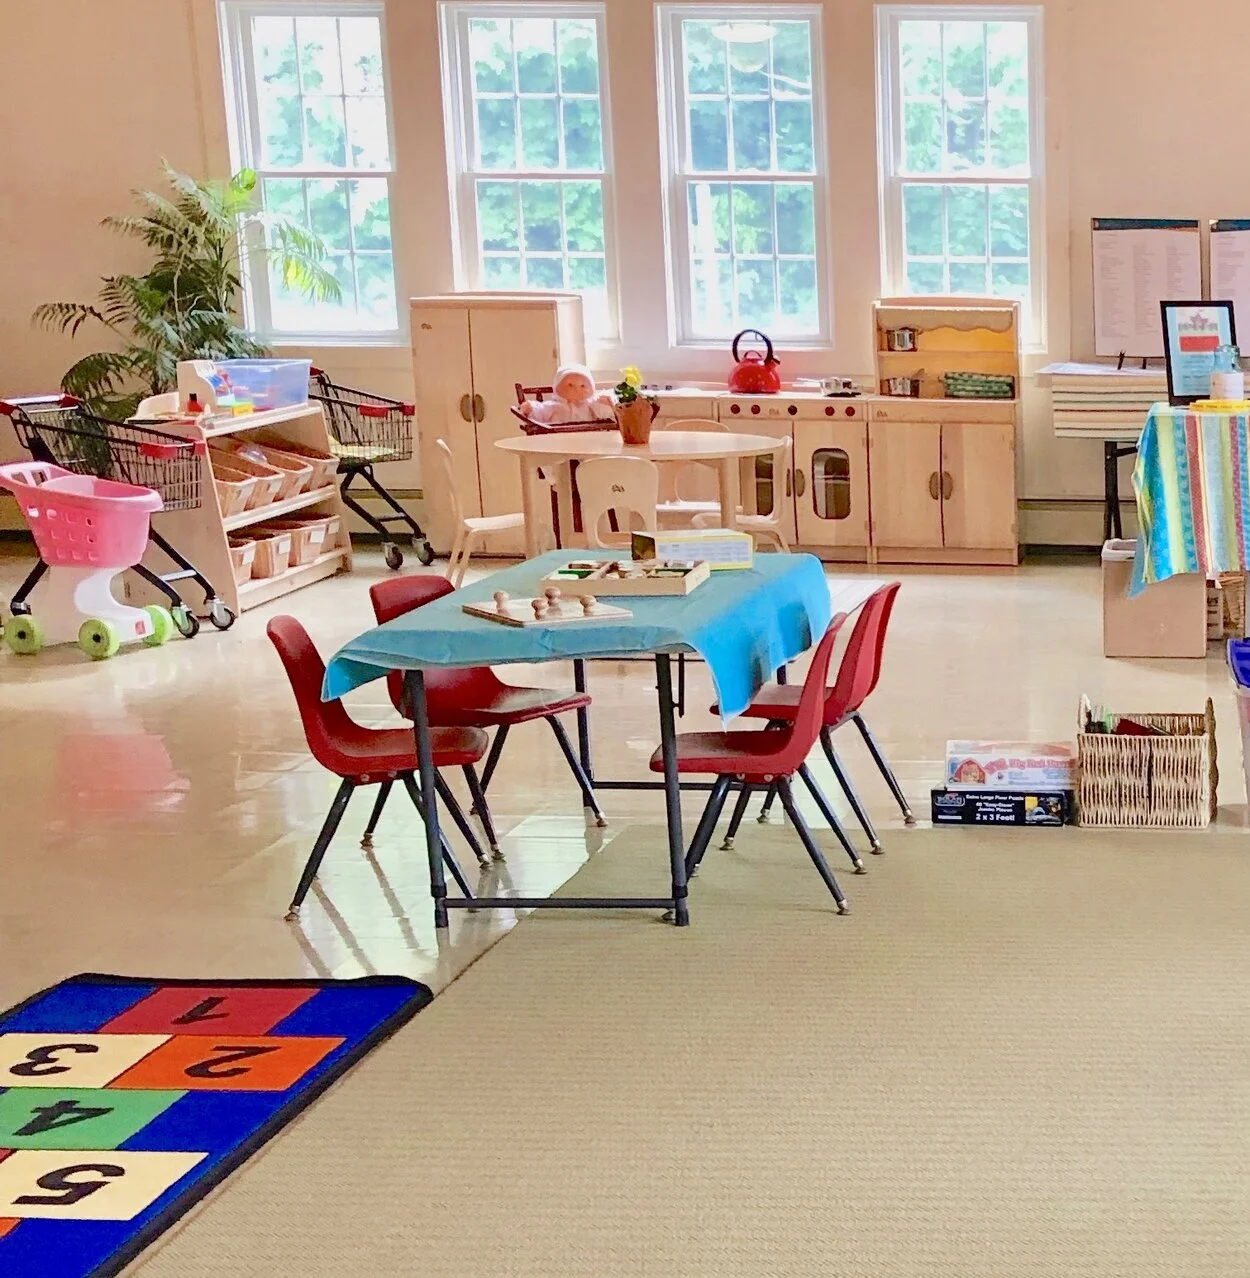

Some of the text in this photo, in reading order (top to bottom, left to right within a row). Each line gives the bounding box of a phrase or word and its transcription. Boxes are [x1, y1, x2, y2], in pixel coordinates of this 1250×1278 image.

[976, 813, 981, 821] 2
[989, 813, 995, 821] 3
[171, 997, 230, 1025] 1
[9, 1043, 282, 1078] 3 2
[12, 1100, 115, 1136] 4
[11, 1164, 125, 1205] 5
